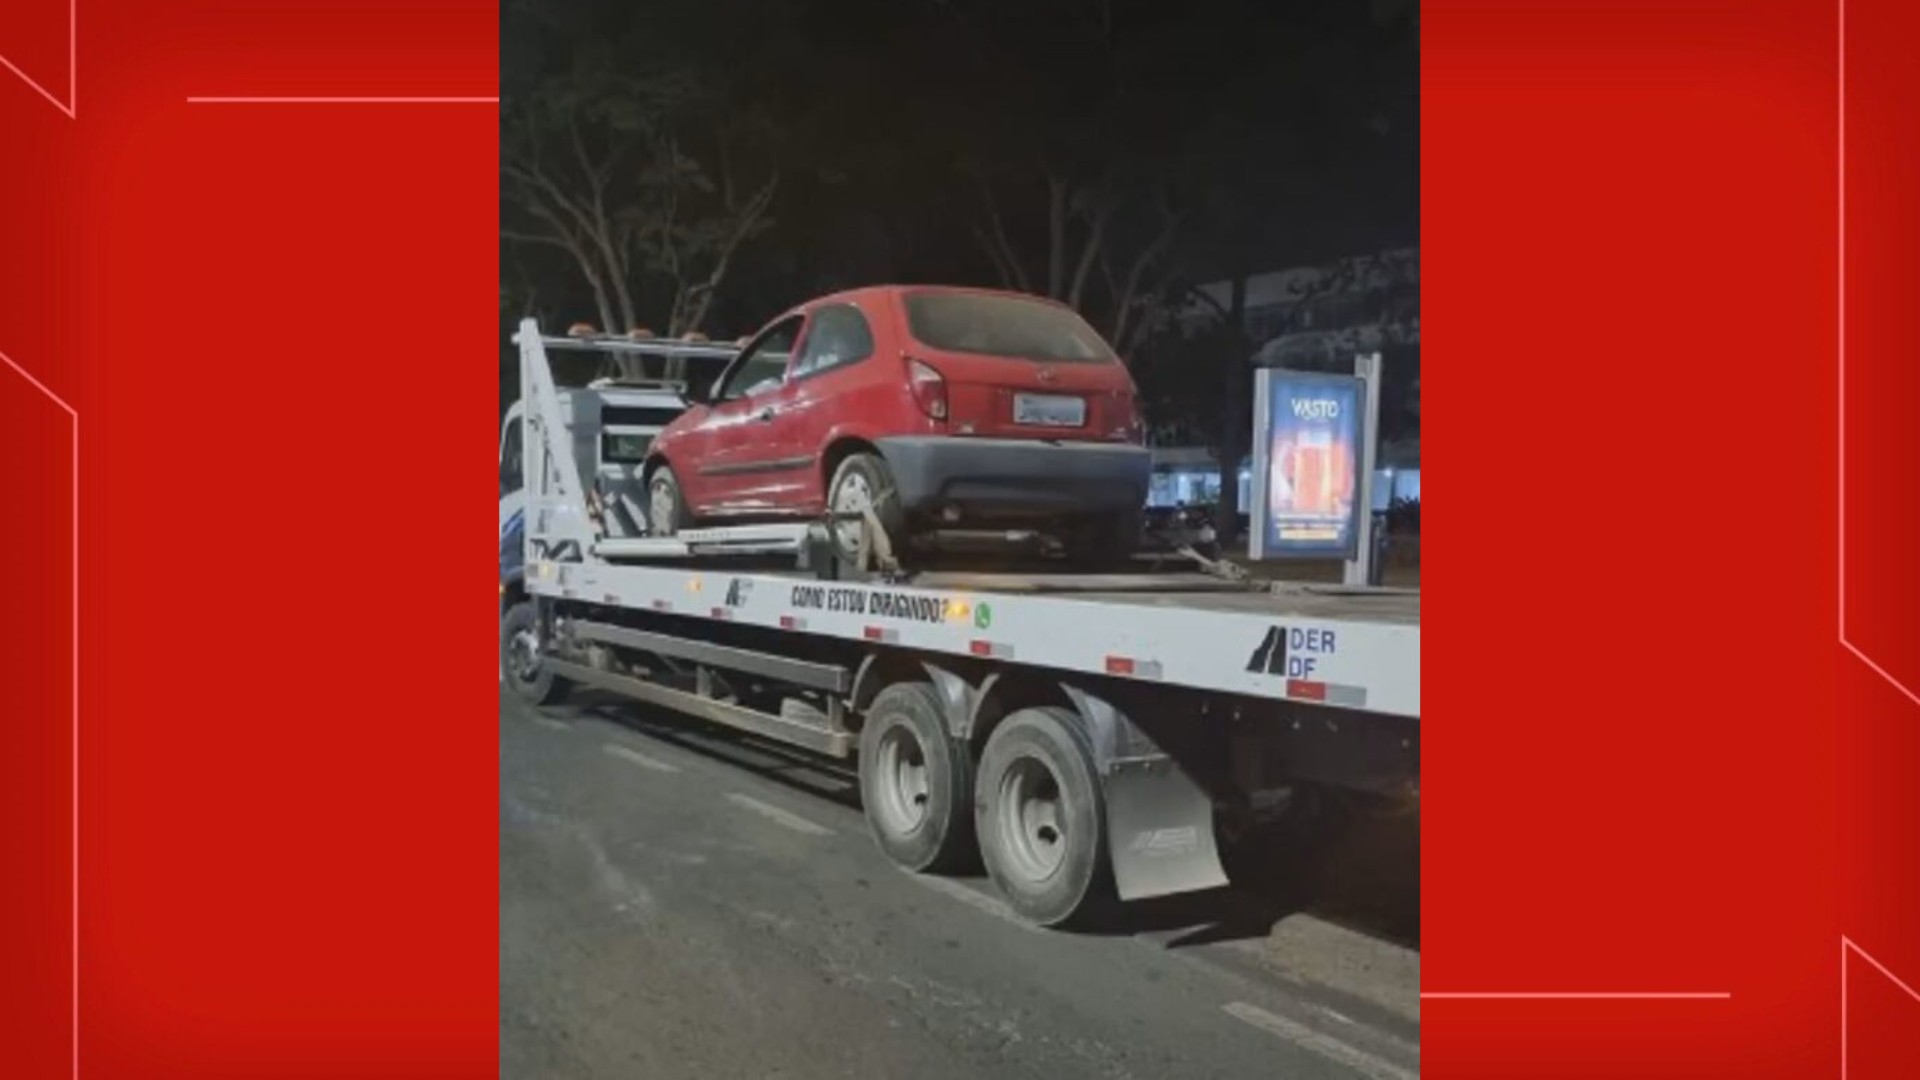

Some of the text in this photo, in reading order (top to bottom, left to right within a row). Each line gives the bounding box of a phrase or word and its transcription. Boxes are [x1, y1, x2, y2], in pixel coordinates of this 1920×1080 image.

[1291, 397, 1339, 419] VASTO
[791, 585, 824, 609] COMO
[828, 588, 867, 614] ESTOU
[1290, 627, 1336, 654] DER
[1288, 656, 1317, 680] DF
